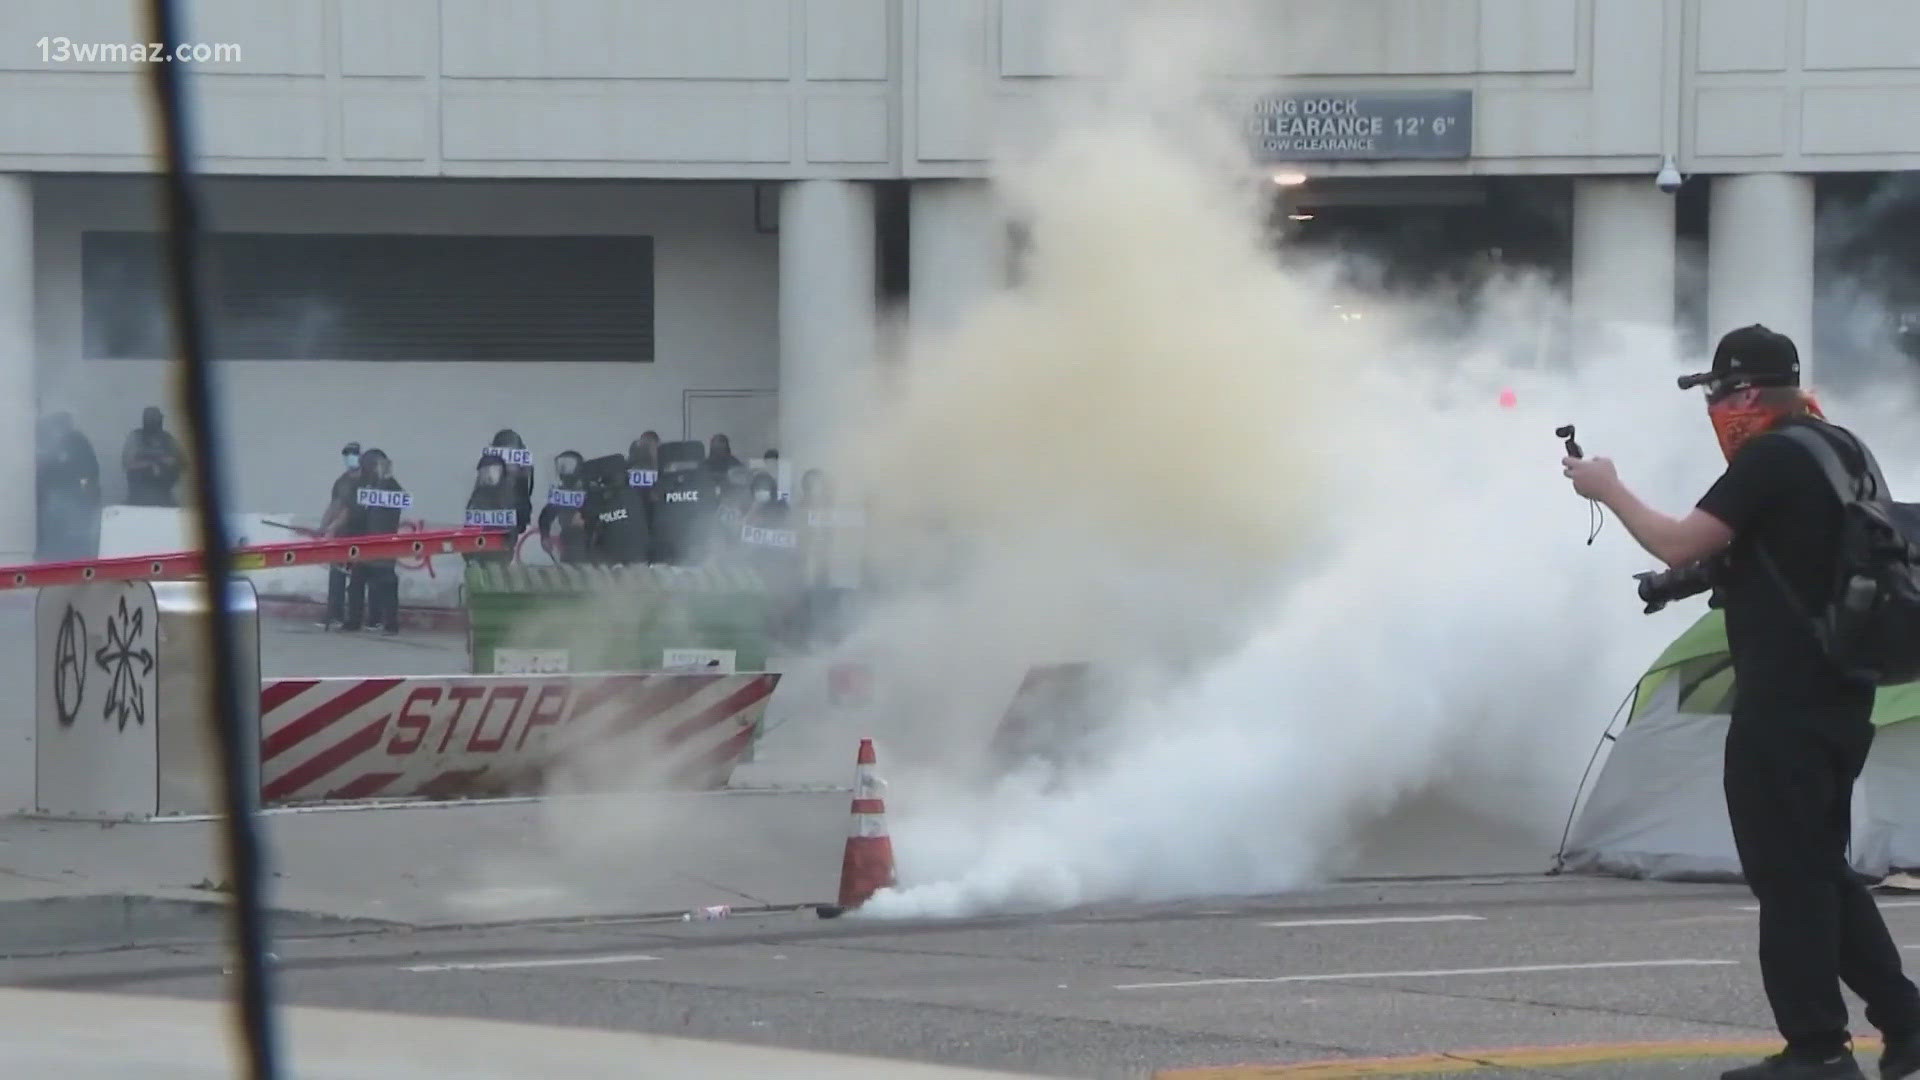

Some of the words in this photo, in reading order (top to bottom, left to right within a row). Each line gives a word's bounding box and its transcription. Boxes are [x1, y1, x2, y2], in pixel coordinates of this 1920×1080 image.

[1304, 100, 1357, 114] DOCK
[1251, 117, 1382, 136] CLEARANCE
[1395, 118, 1424, 136] 12'
[1432, 118, 1455, 136] 6"
[1294, 139, 1374, 150] CLEARANCE
[360, 491, 410, 506] POLICE
[666, 491, 698, 502] POLICE
[465, 510, 513, 525] POLICE
[599, 509, 628, 522] POLICE
[386, 685, 569, 755] STOP
